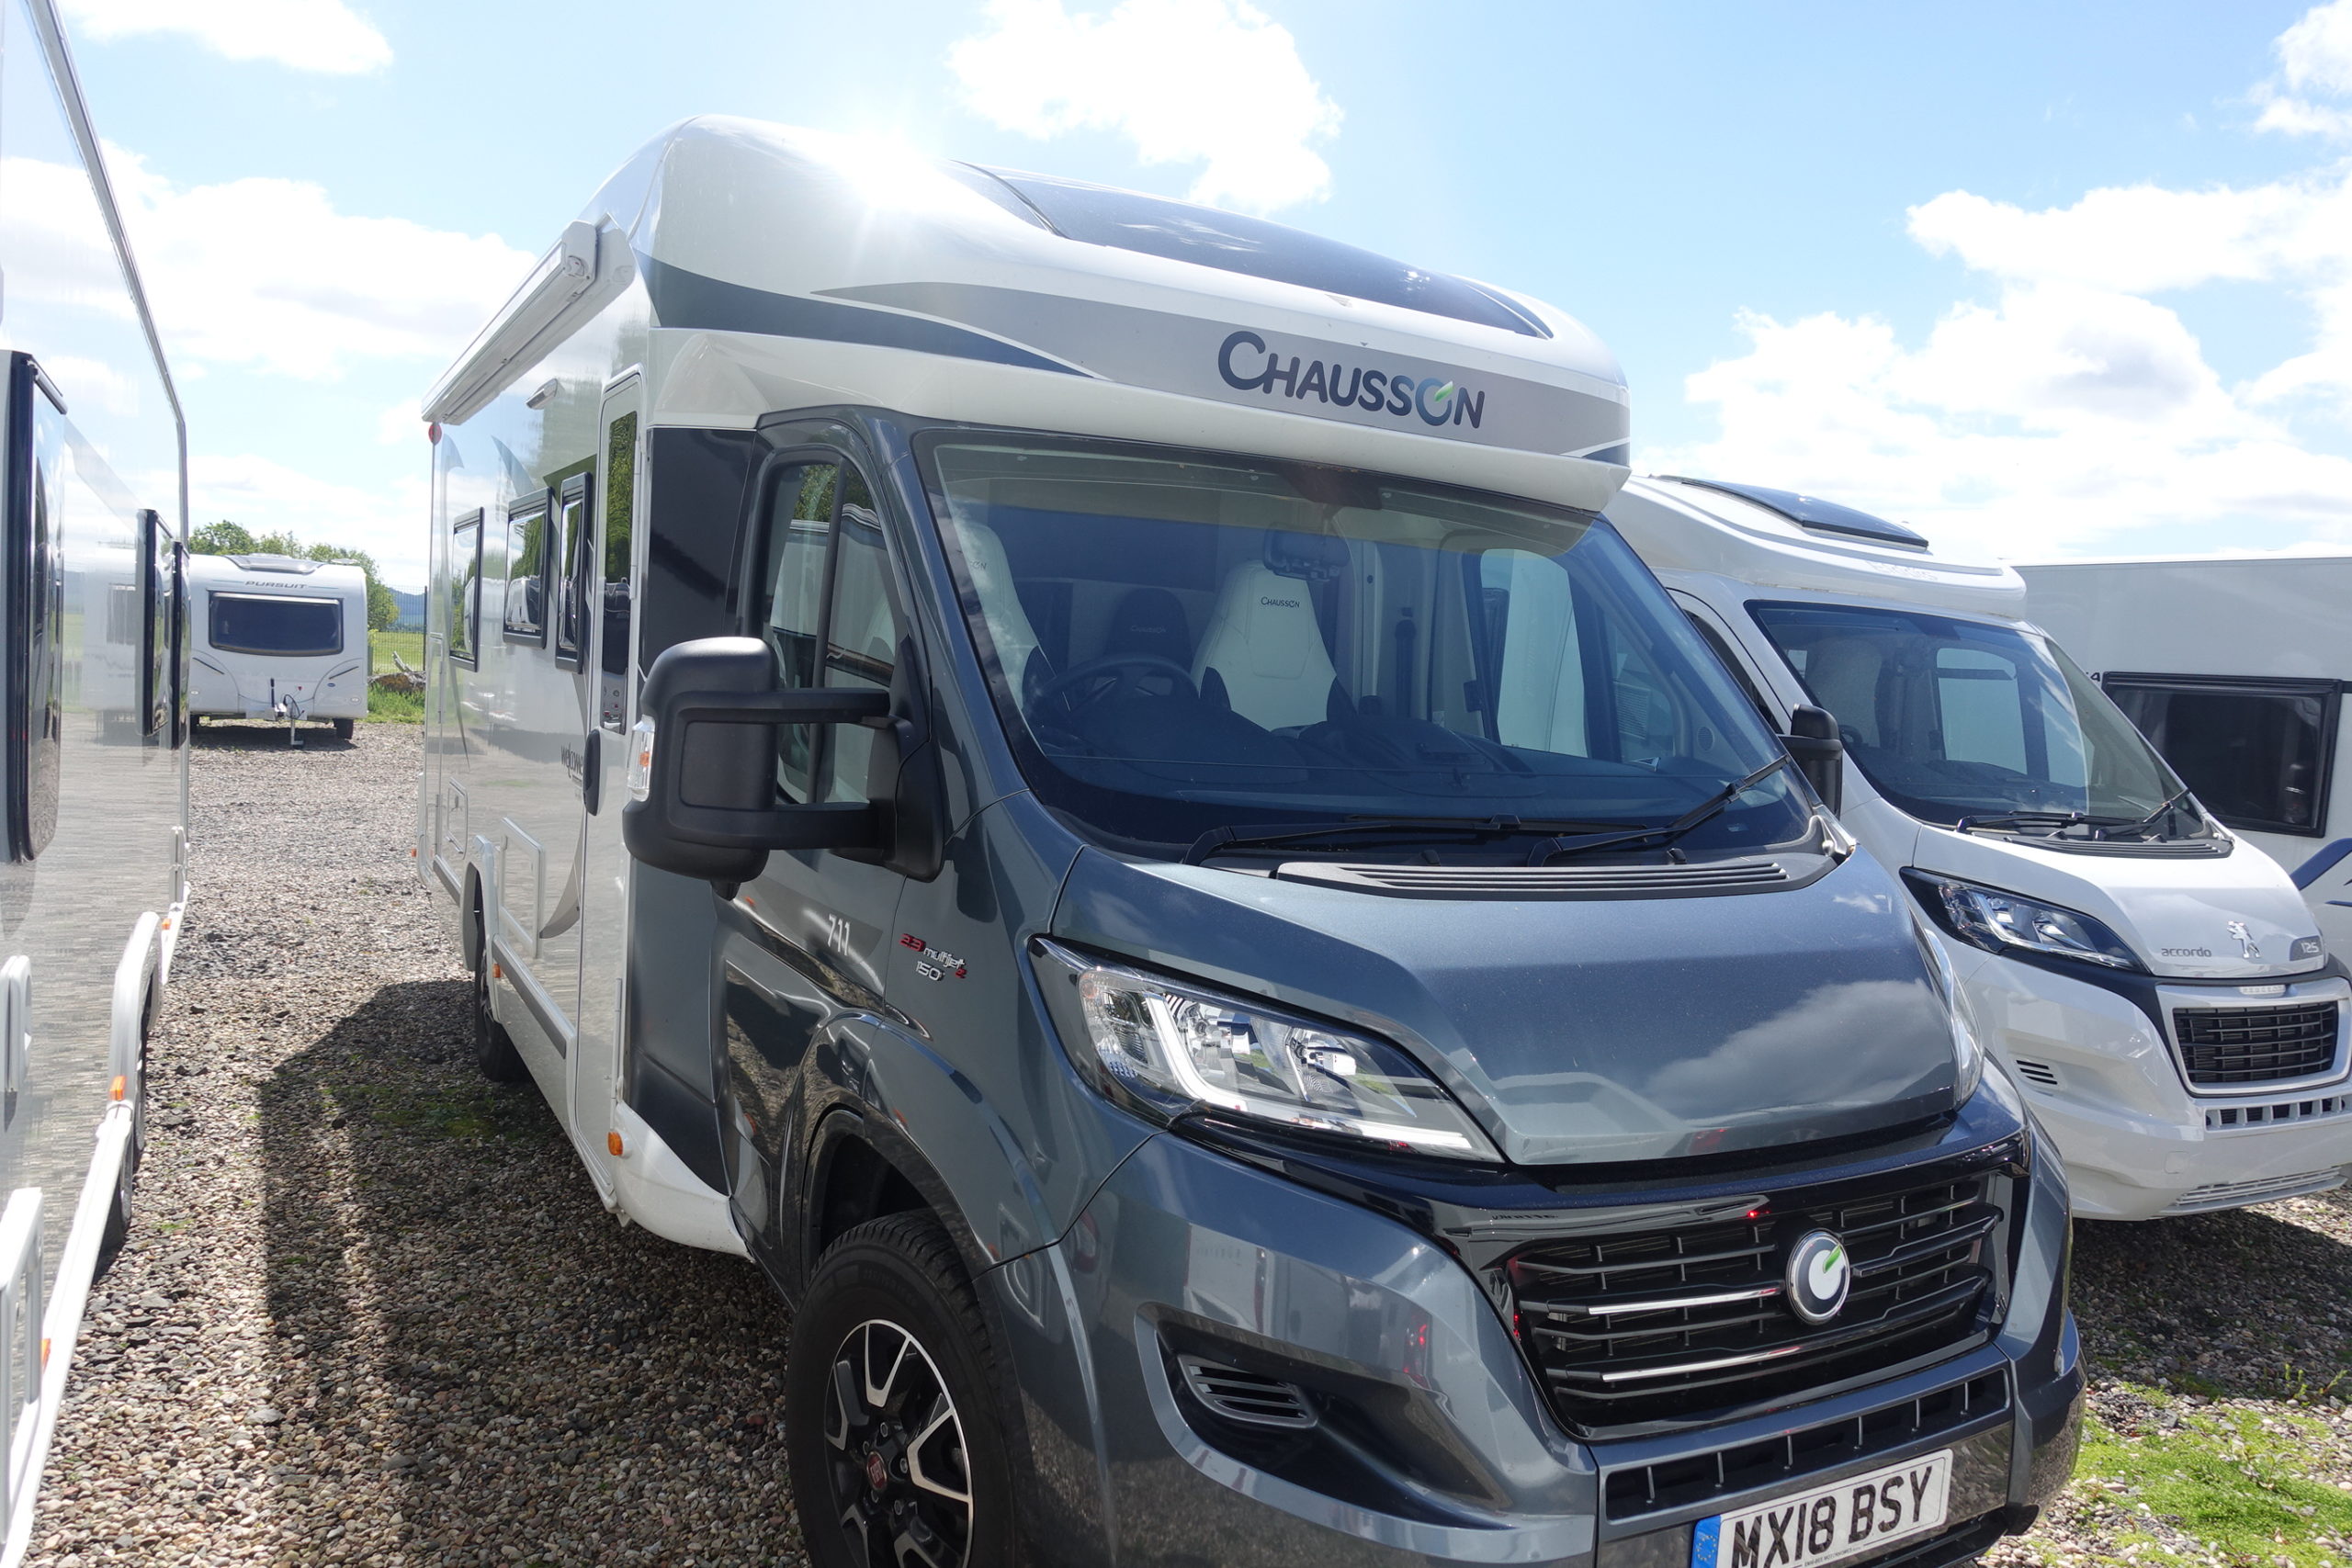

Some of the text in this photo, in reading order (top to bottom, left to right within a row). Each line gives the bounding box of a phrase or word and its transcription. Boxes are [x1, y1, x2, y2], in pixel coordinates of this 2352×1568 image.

[1217, 330, 1486, 429] CHAUSSON
[244, 580, 308, 589] PURSUIT
[1260, 596, 1300, 608] CHAUSSON
[828, 913, 851, 956] 711
[2161, 947, 2212, 958] accordo
[2301, 942, 2320, 953] 125
[915, 961, 941, 981] 150
[1730, 1466, 1933, 1568] MX18 BSY
